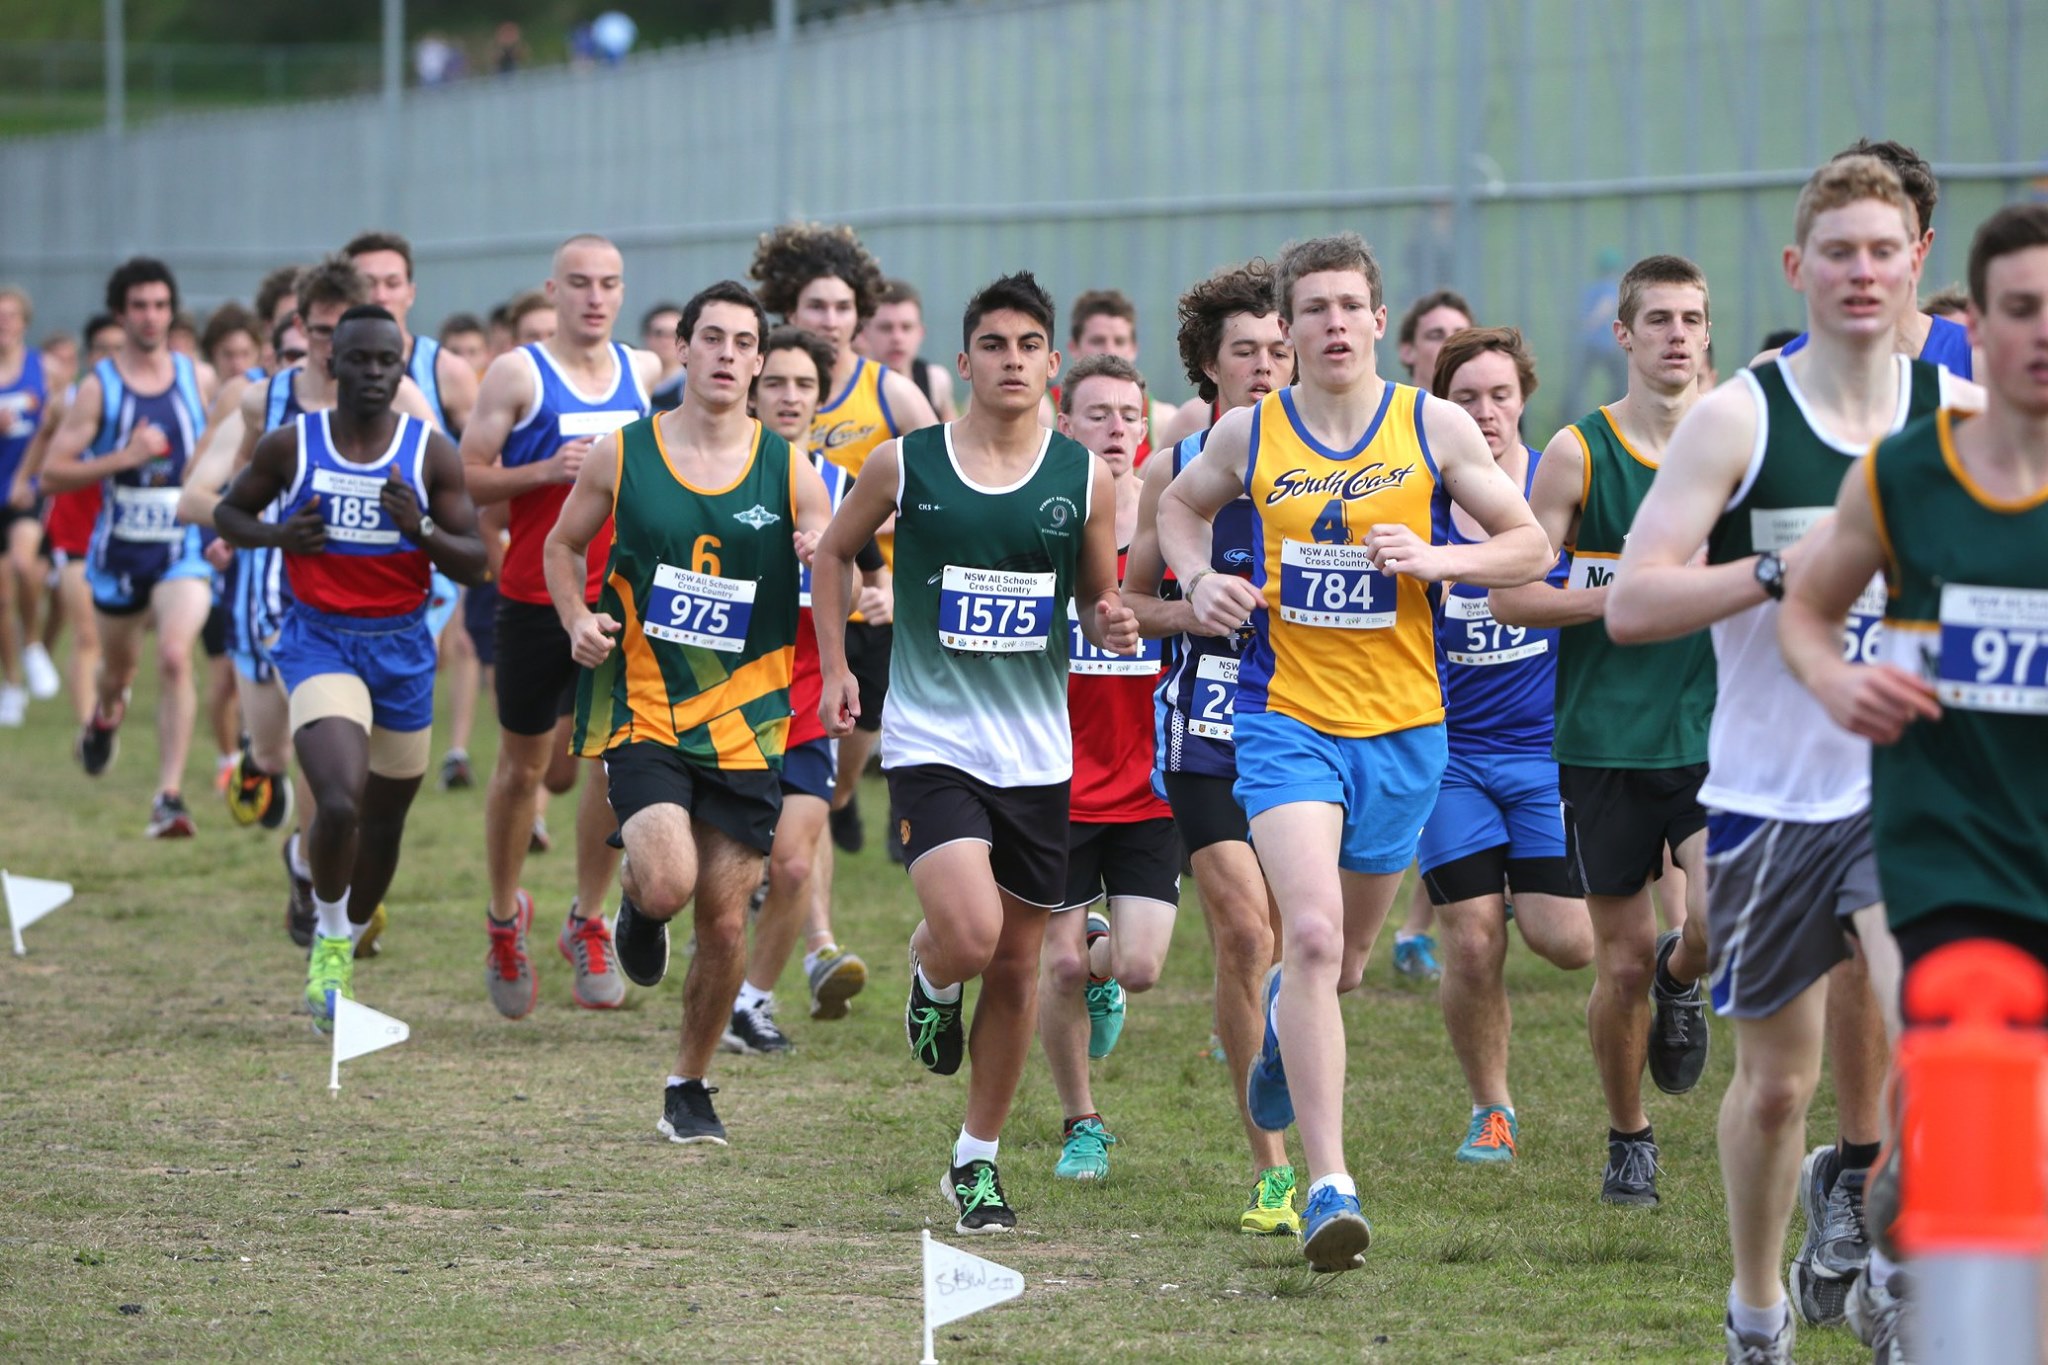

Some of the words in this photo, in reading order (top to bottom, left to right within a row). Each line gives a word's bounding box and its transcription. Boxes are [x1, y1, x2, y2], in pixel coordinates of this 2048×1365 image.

[1265, 468, 1347, 507] South
[1341, 462, 1417, 502] Coast
[329, 495, 381, 530] 185
[1050, 504, 1068, 529] 9
[1310, 498, 1354, 545] 4
[691, 534, 722, 577] 6
[1299, 546, 1322, 556] NSW
[1324, 549, 1338, 558] All
[1305, 556, 1331, 566] Cross
[1333, 558, 1371, 569] Country
[674, 572, 695, 582] NSW
[695, 576, 708, 585] All
[709, 579, 739, 591] Schools
[677, 581, 700, 592] Cross
[702, 586, 733, 599] Country
[964, 572, 986, 582] NSW
[988, 574, 1001, 583] All
[1003, 575, 1038, 586] Schools
[969, 582, 994, 592] Cross
[996, 584, 1031, 595] Country
[1301, 570, 1374, 611] 784
[669, 594, 731, 634] 975
[957, 595, 1037, 635] 1575
[1461, 601, 1481, 610] NSW
[1466, 609, 1489, 617] Cross
[1466, 619, 1527, 652] 579
